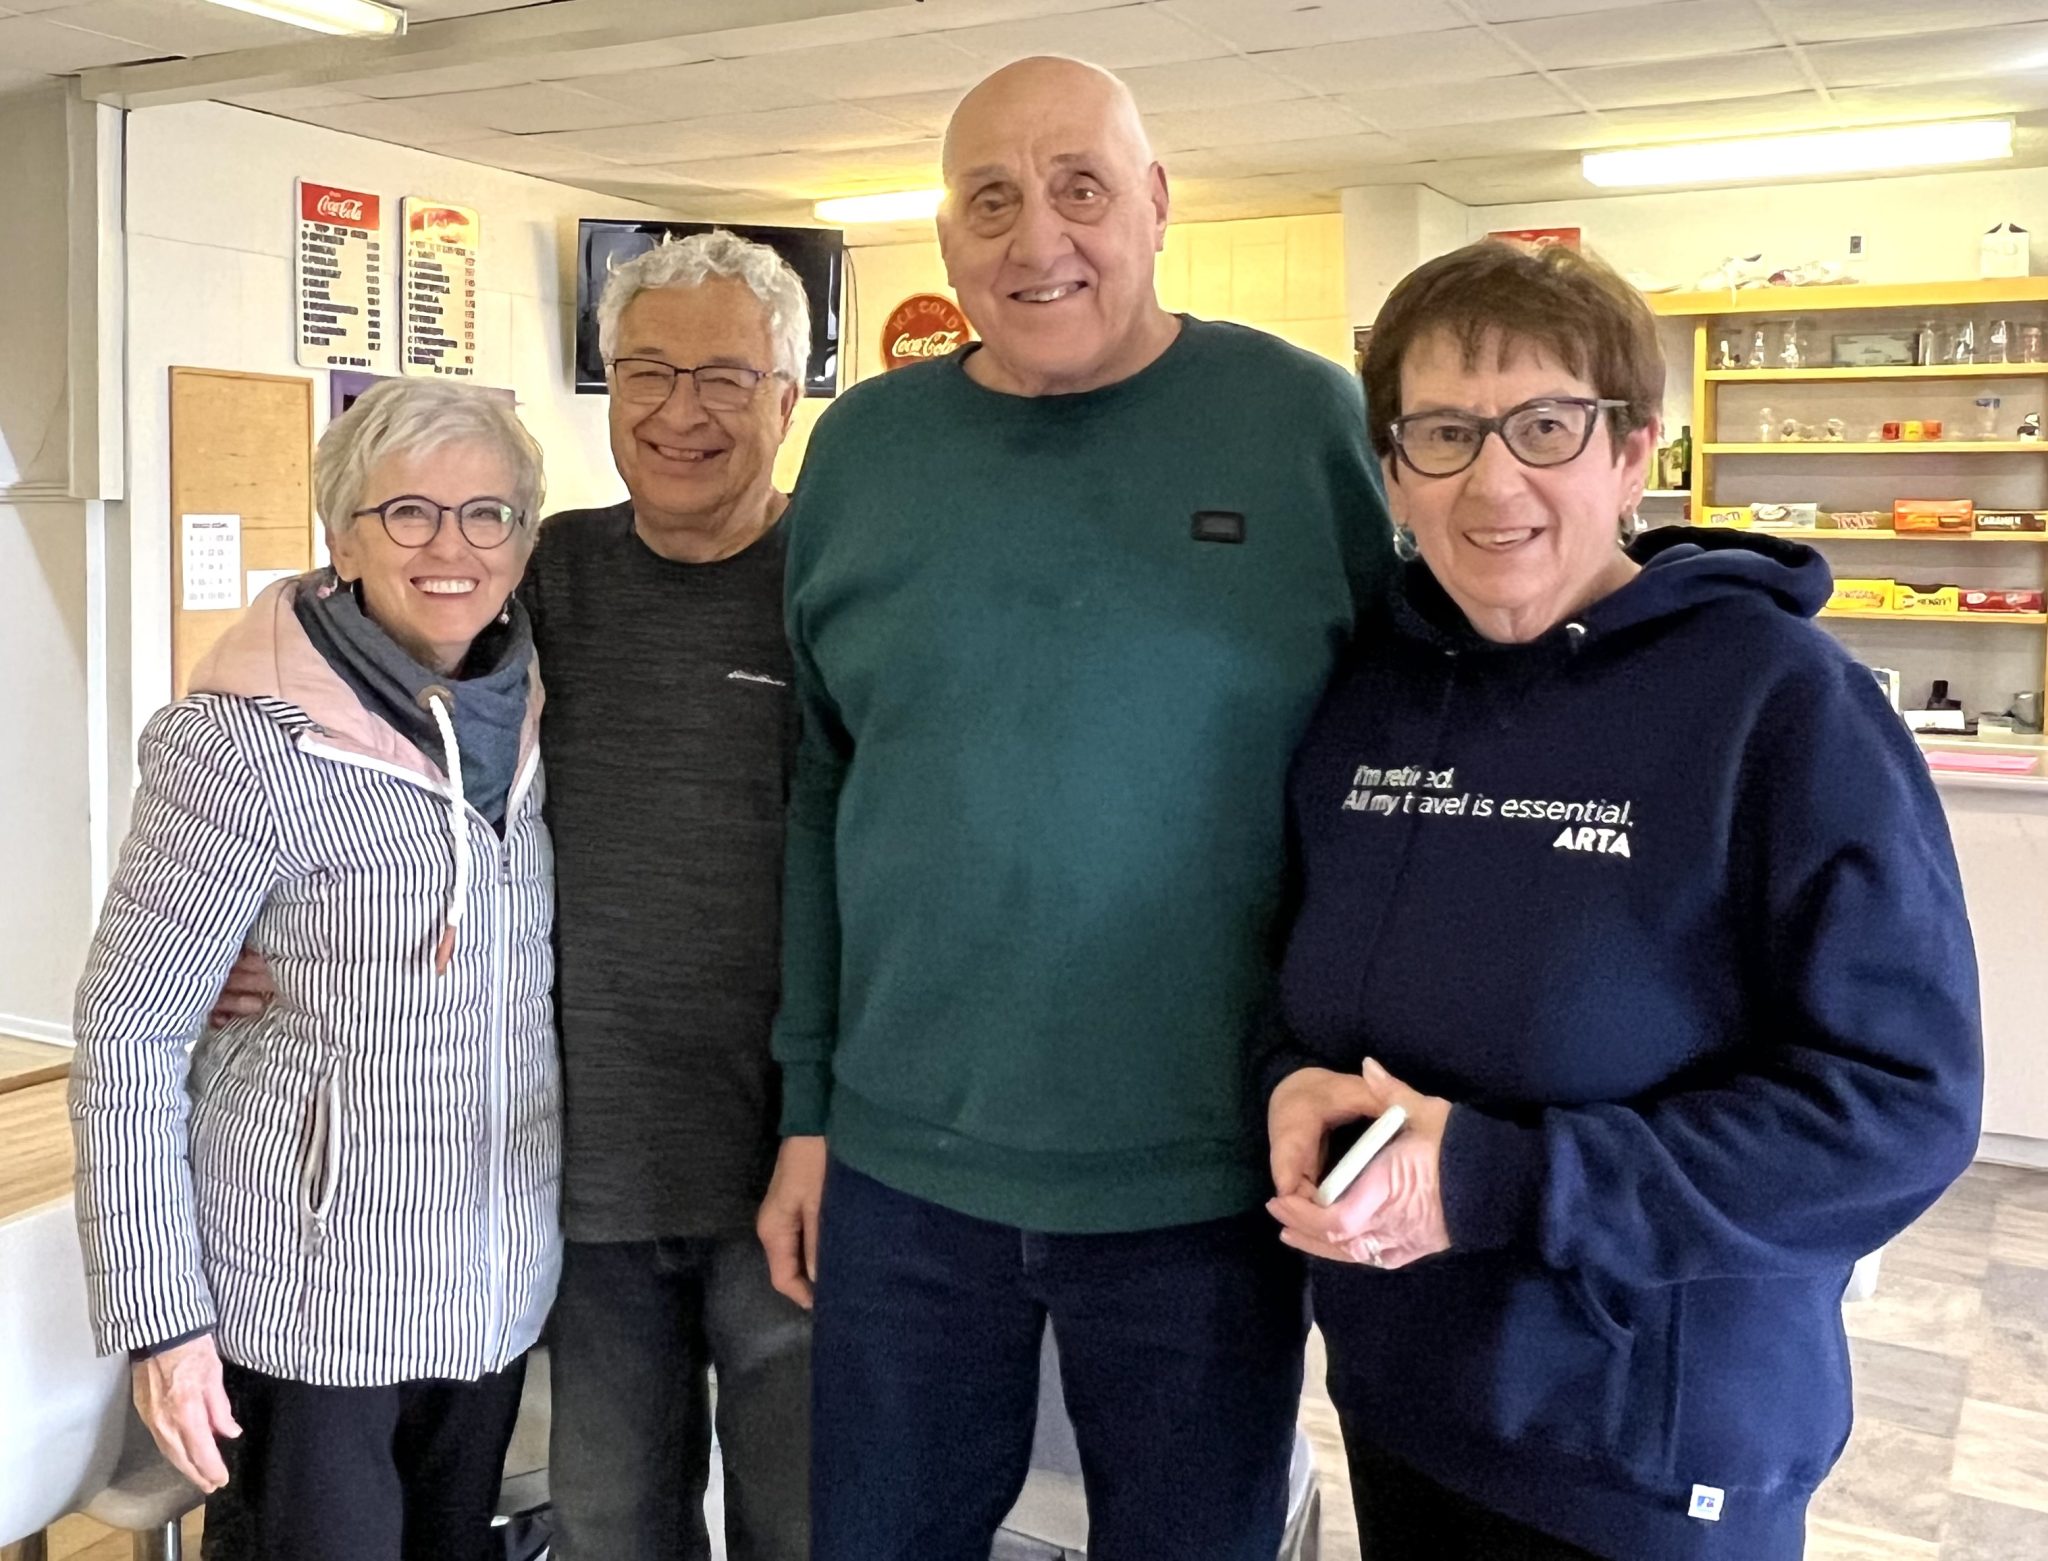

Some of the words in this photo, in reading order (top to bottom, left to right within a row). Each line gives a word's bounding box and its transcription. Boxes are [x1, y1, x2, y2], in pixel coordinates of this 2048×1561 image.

[317, 195, 364, 221] Coca-Cola
[893, 306, 916, 331] ICE
[918, 300, 959, 329] COLD
[892, 330, 961, 358] Coca-Cola
[1353, 765, 1382, 786] I'm
[1370, 794, 1401, 817] my
[1402, 791, 1471, 816] tavel
[1472, 793, 1495, 817] is
[1500, 798, 1634, 827] essential.
[1552, 826, 1631, 859] ARTA
